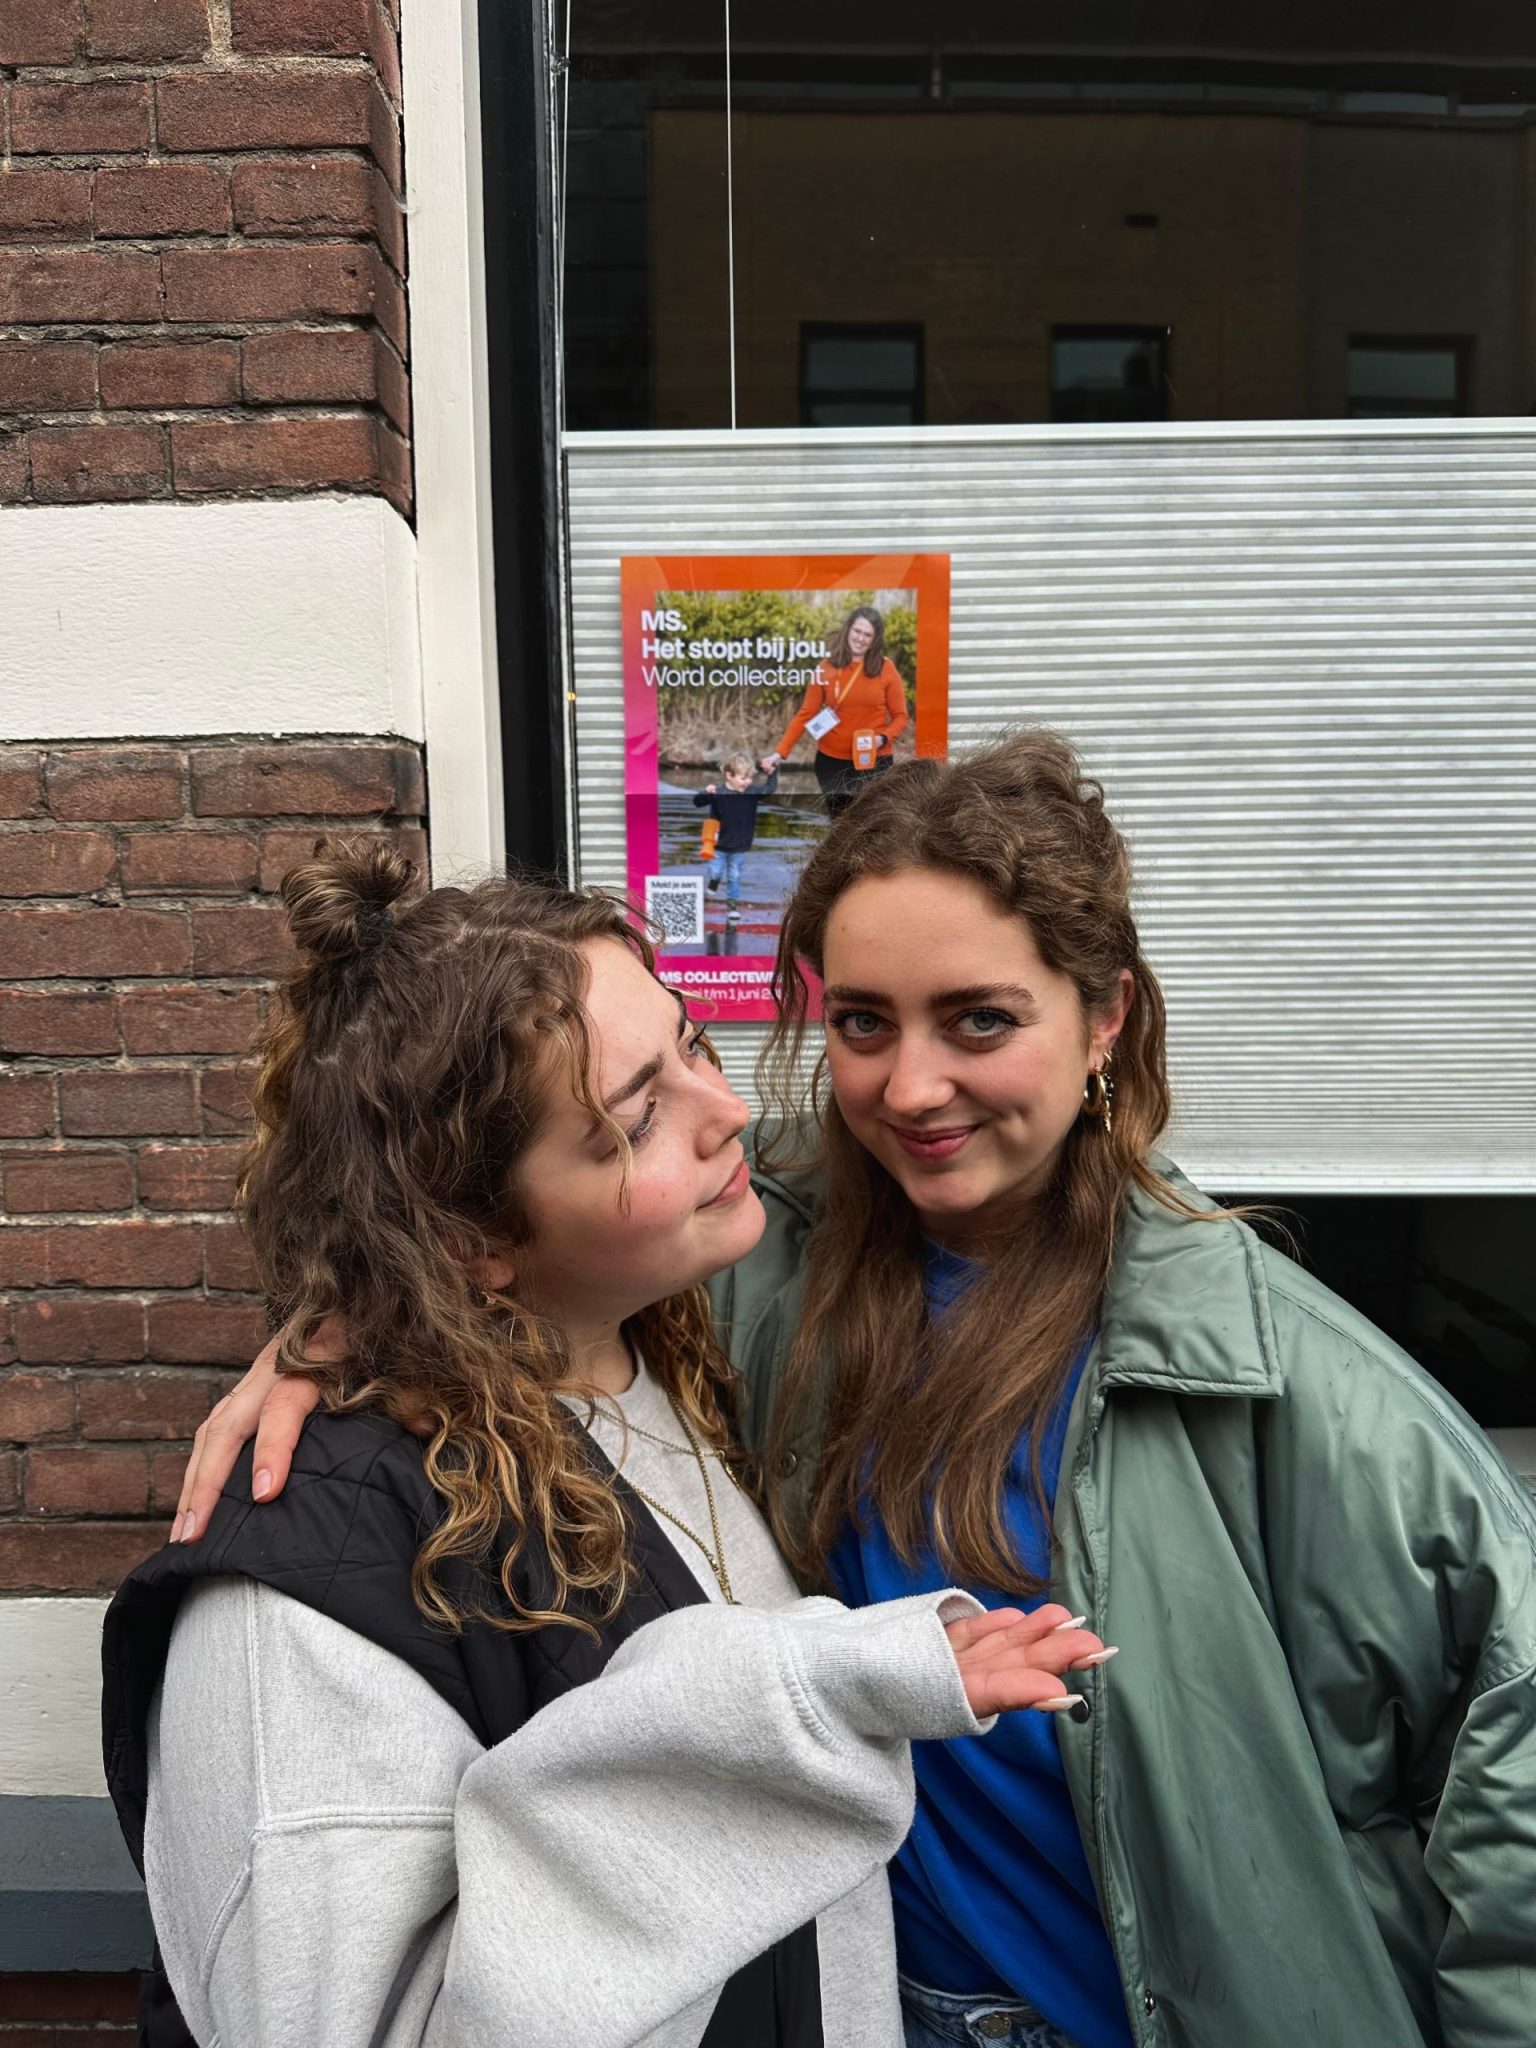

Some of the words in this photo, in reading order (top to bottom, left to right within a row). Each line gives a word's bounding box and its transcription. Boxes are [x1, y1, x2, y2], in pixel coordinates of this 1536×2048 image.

[641, 610, 688, 631] MS.
[641, 638, 685, 659] Het
[688, 638, 753, 663] stopt
[756, 637, 785, 663] bij
[787, 637, 832, 663] jou.
[641, 665, 704, 687] Word
[708, 665, 829, 687] collectant.
[659, 971, 682, 983] MS
[684, 971, 784, 983] COLLECTEW
[736, 987, 760, 1002] juni
